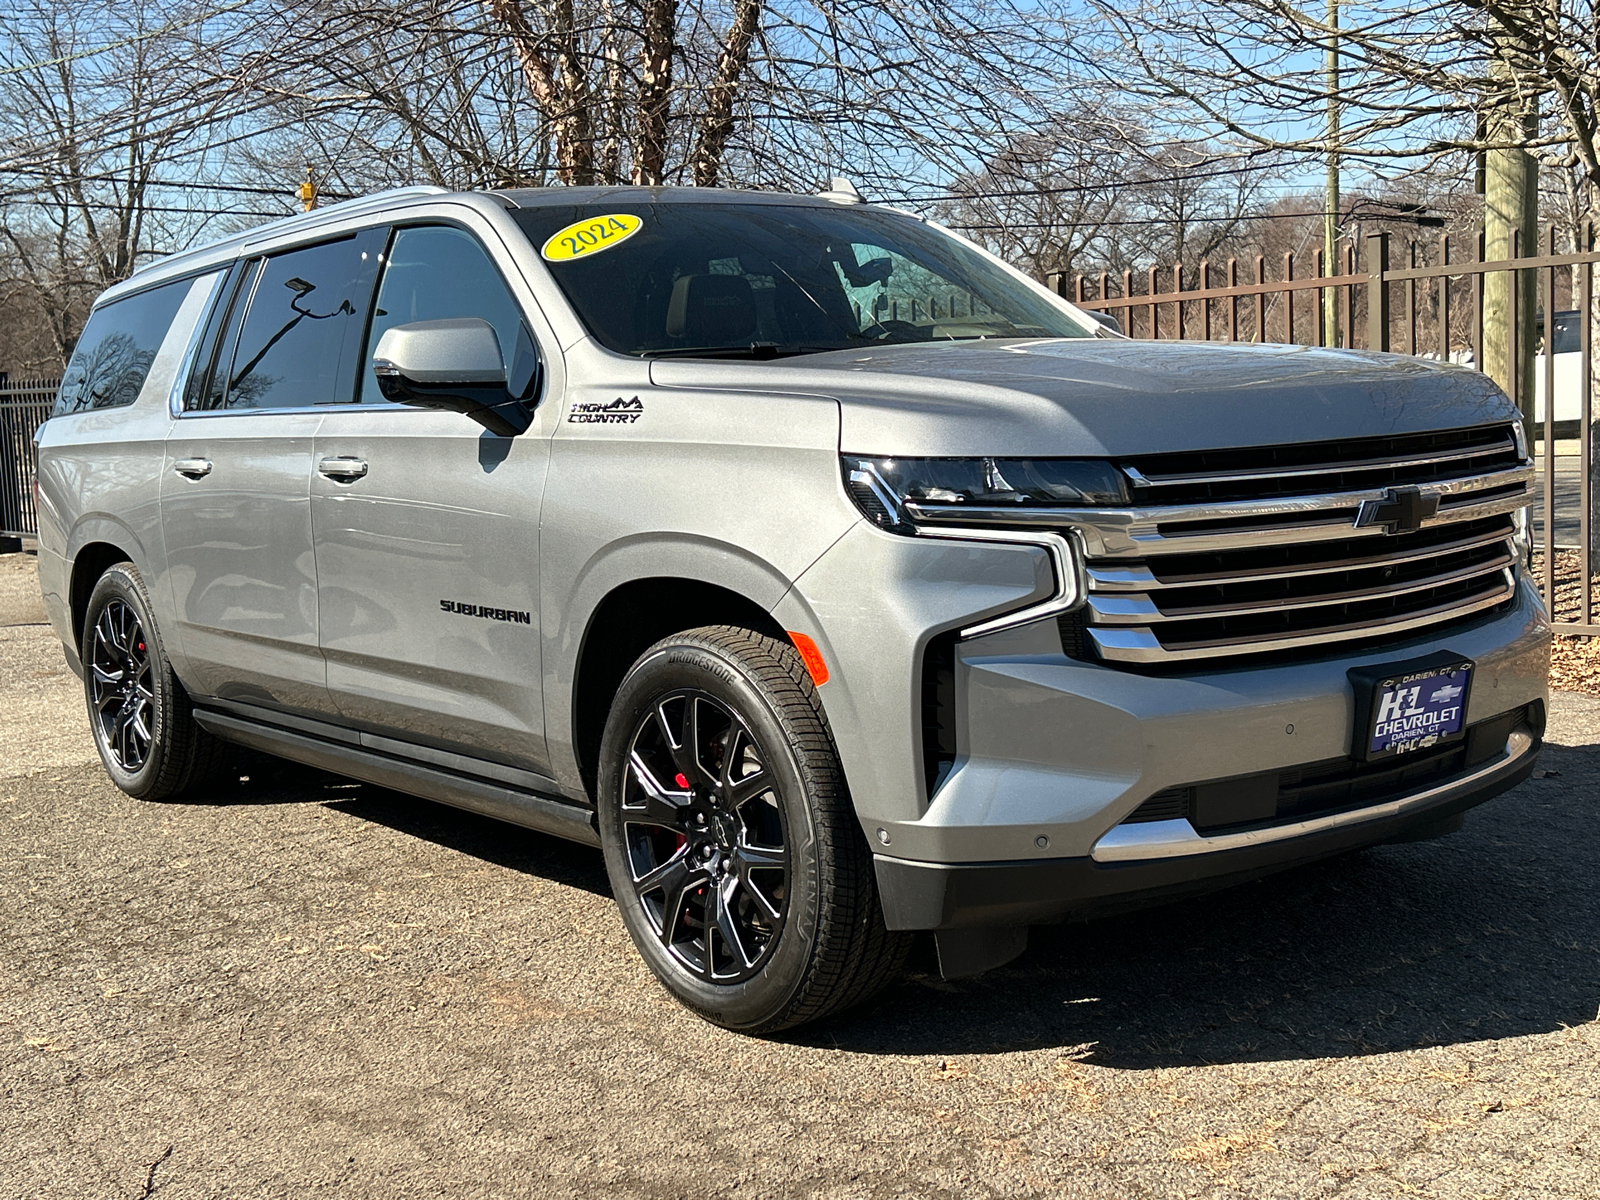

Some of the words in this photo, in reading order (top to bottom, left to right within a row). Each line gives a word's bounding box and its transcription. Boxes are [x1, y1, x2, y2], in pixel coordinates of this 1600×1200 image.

[561, 218, 629, 254] 2024
[568, 414, 641, 423] COUNTRY
[571, 403, 608, 412] HIGH
[440, 600, 530, 624] SUBURBAN
[668, 651, 737, 687] BRIDGESTONE
[1376, 686, 1424, 723] H&L
[1375, 706, 1460, 737] CHEVROLET
[804, 854, 816, 926] ALENZA
